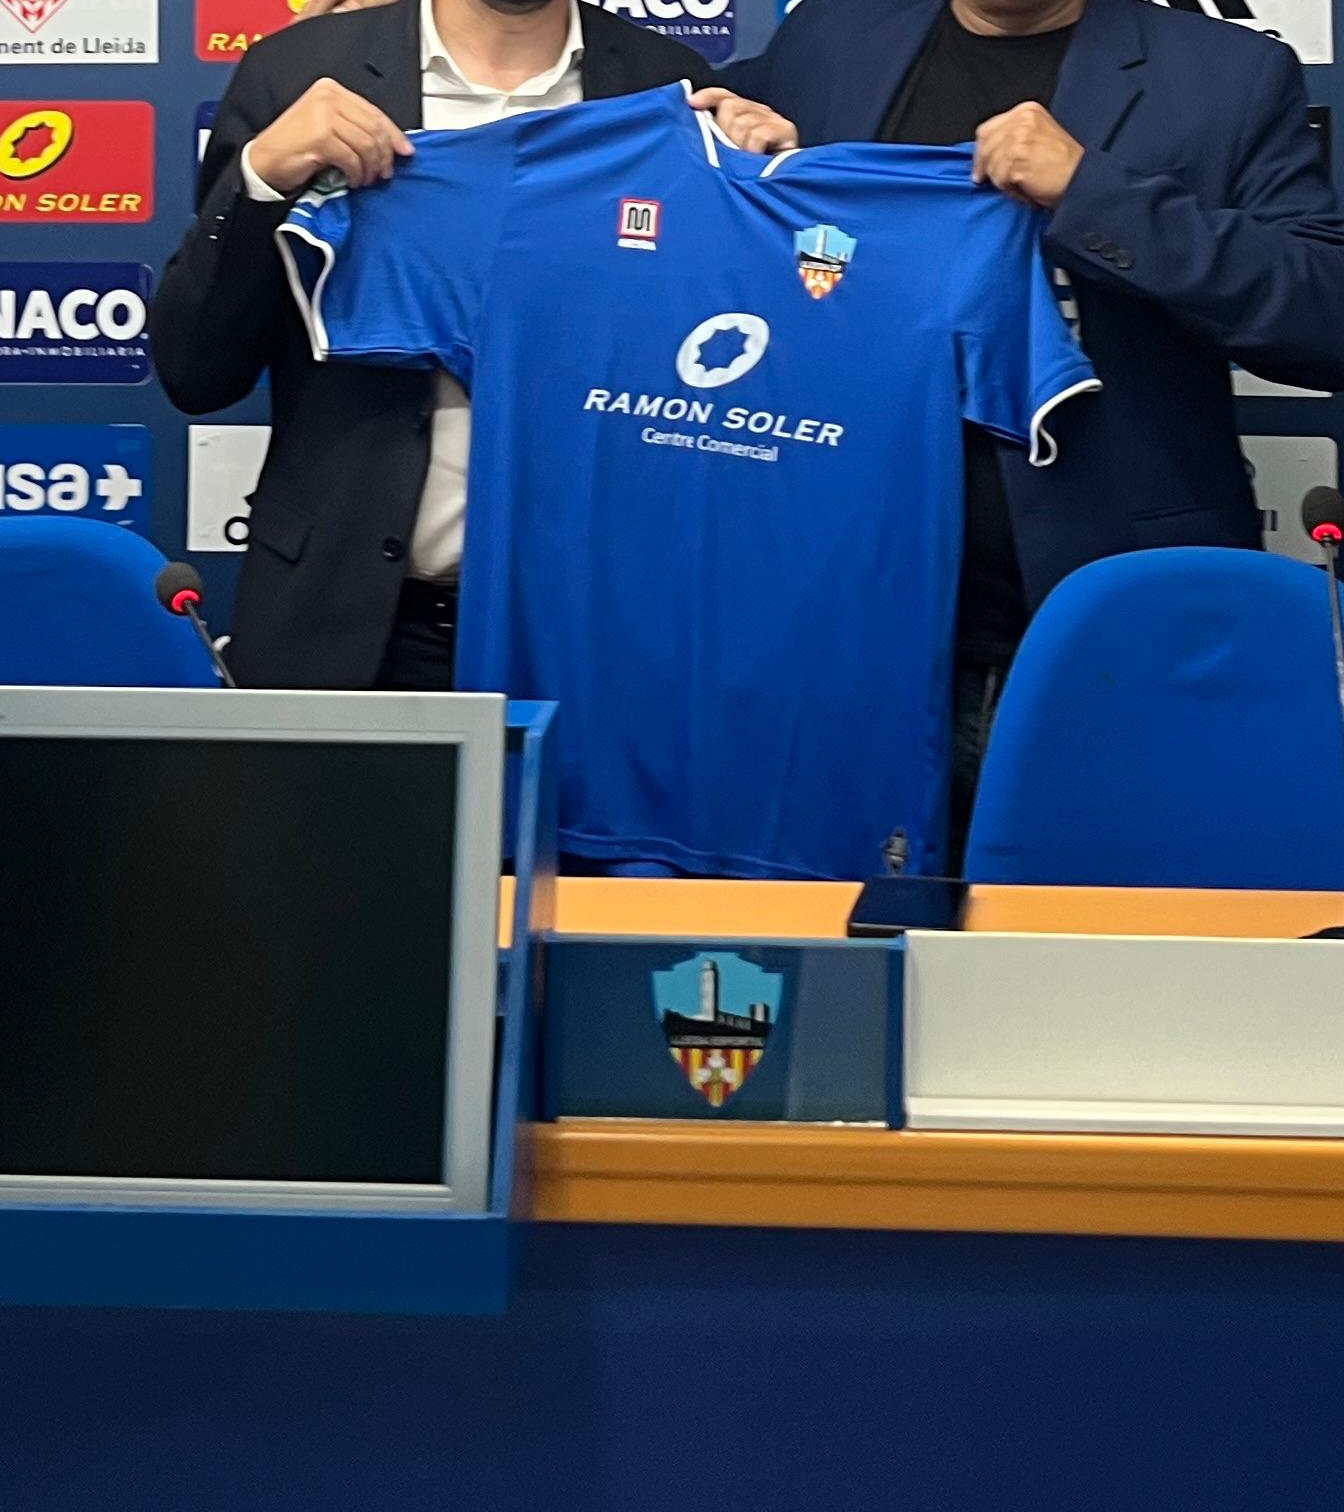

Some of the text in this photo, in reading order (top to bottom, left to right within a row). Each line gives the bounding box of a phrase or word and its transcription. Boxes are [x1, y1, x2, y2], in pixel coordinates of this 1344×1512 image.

[51, 38, 76, 54] de
[83, 38, 145, 53] Lleida
[36, 194, 141, 211] SOLER
[584, 388, 844, 447] RAMON SOLER
[641, 427, 779, 462] Centre Comercial
